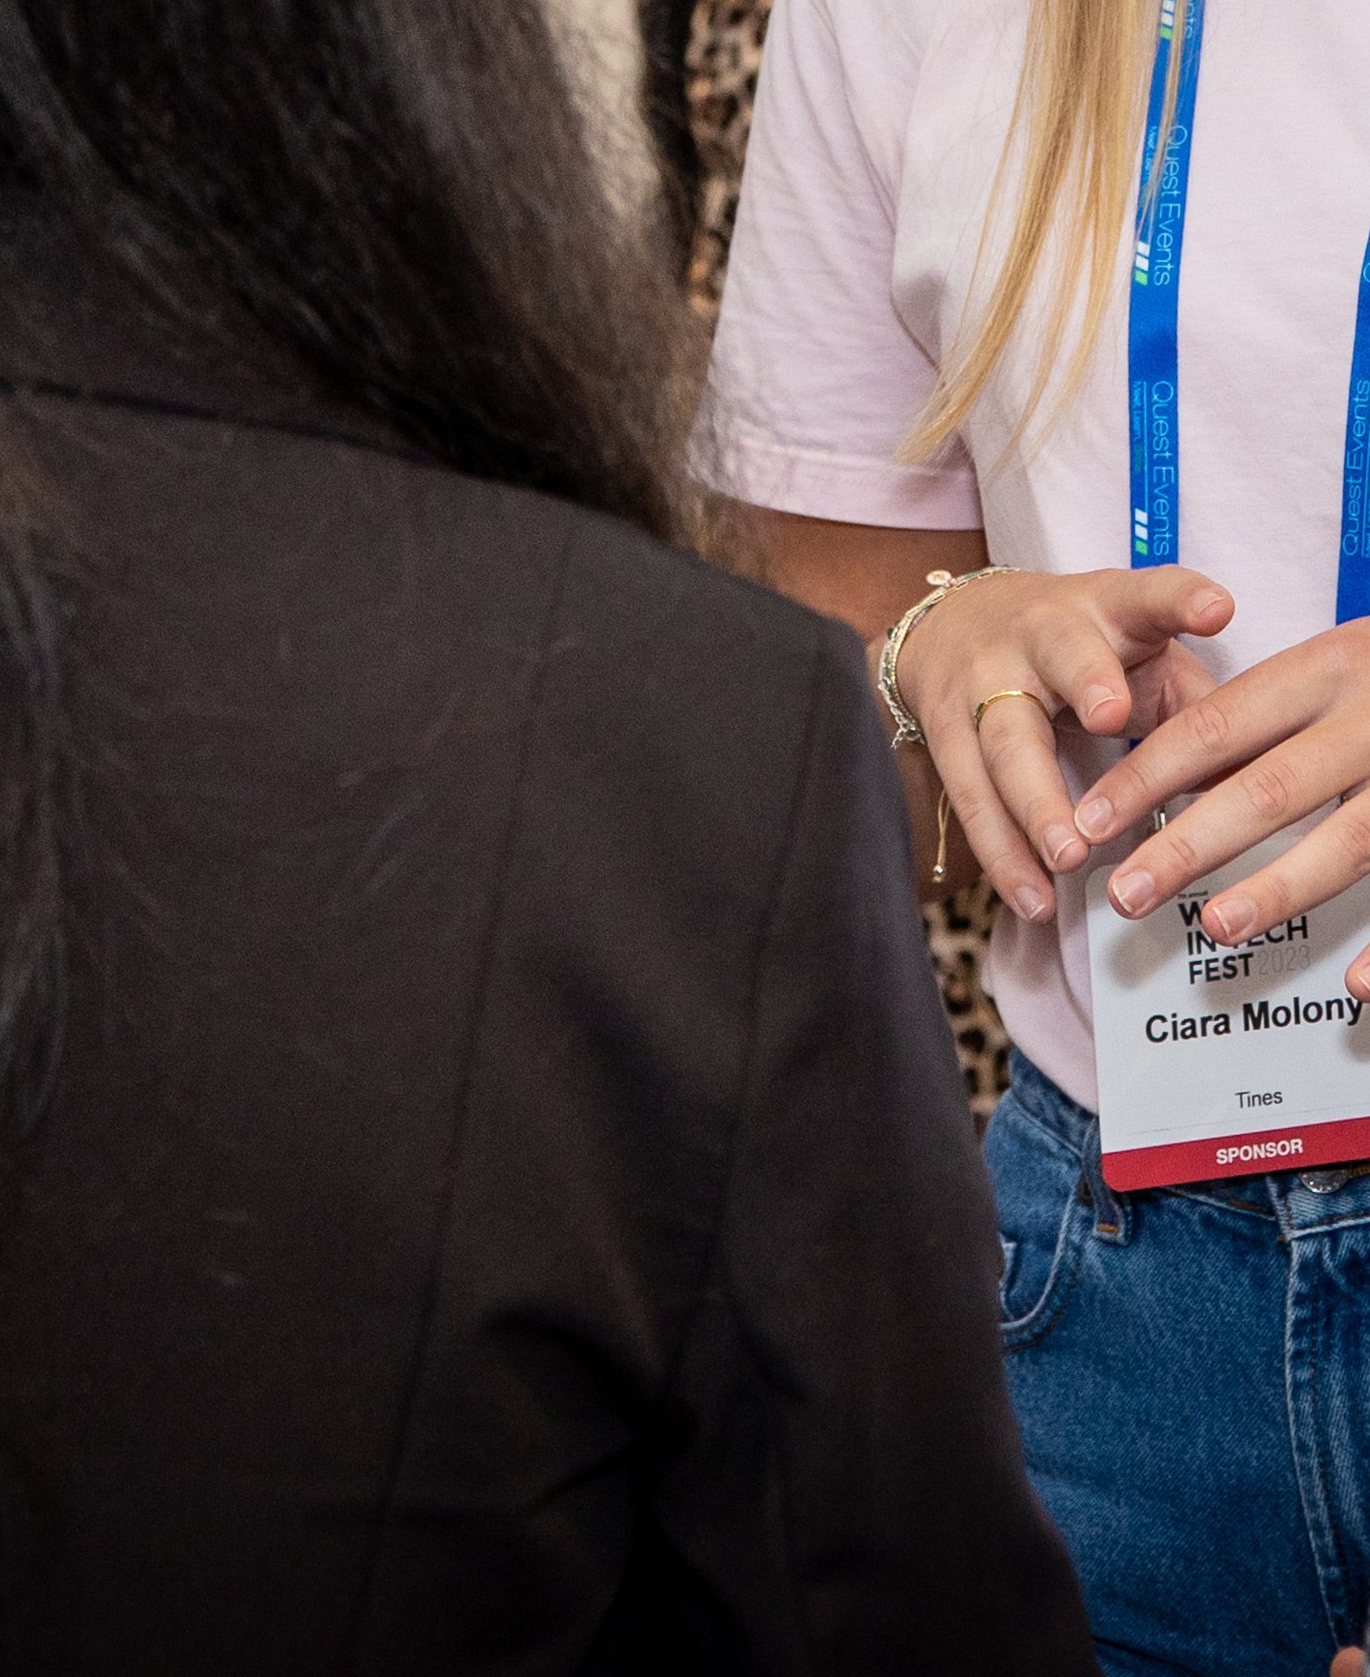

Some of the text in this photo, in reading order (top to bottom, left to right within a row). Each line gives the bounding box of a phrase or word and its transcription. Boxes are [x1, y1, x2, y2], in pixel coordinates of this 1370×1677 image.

[1153, 125, 1188, 286] Quest Events
[1152, 380, 1175, 555] Quest Events
[1343, 380, 1370, 556] Quest Events
[1189, 944, 1312, 985] FEST 2023
[1145, 996, 1364, 1043] Ciara Molony
[1235, 1091, 1284, 1109] Tines
[1216, 1138, 1304, 1165] SPONSOR
